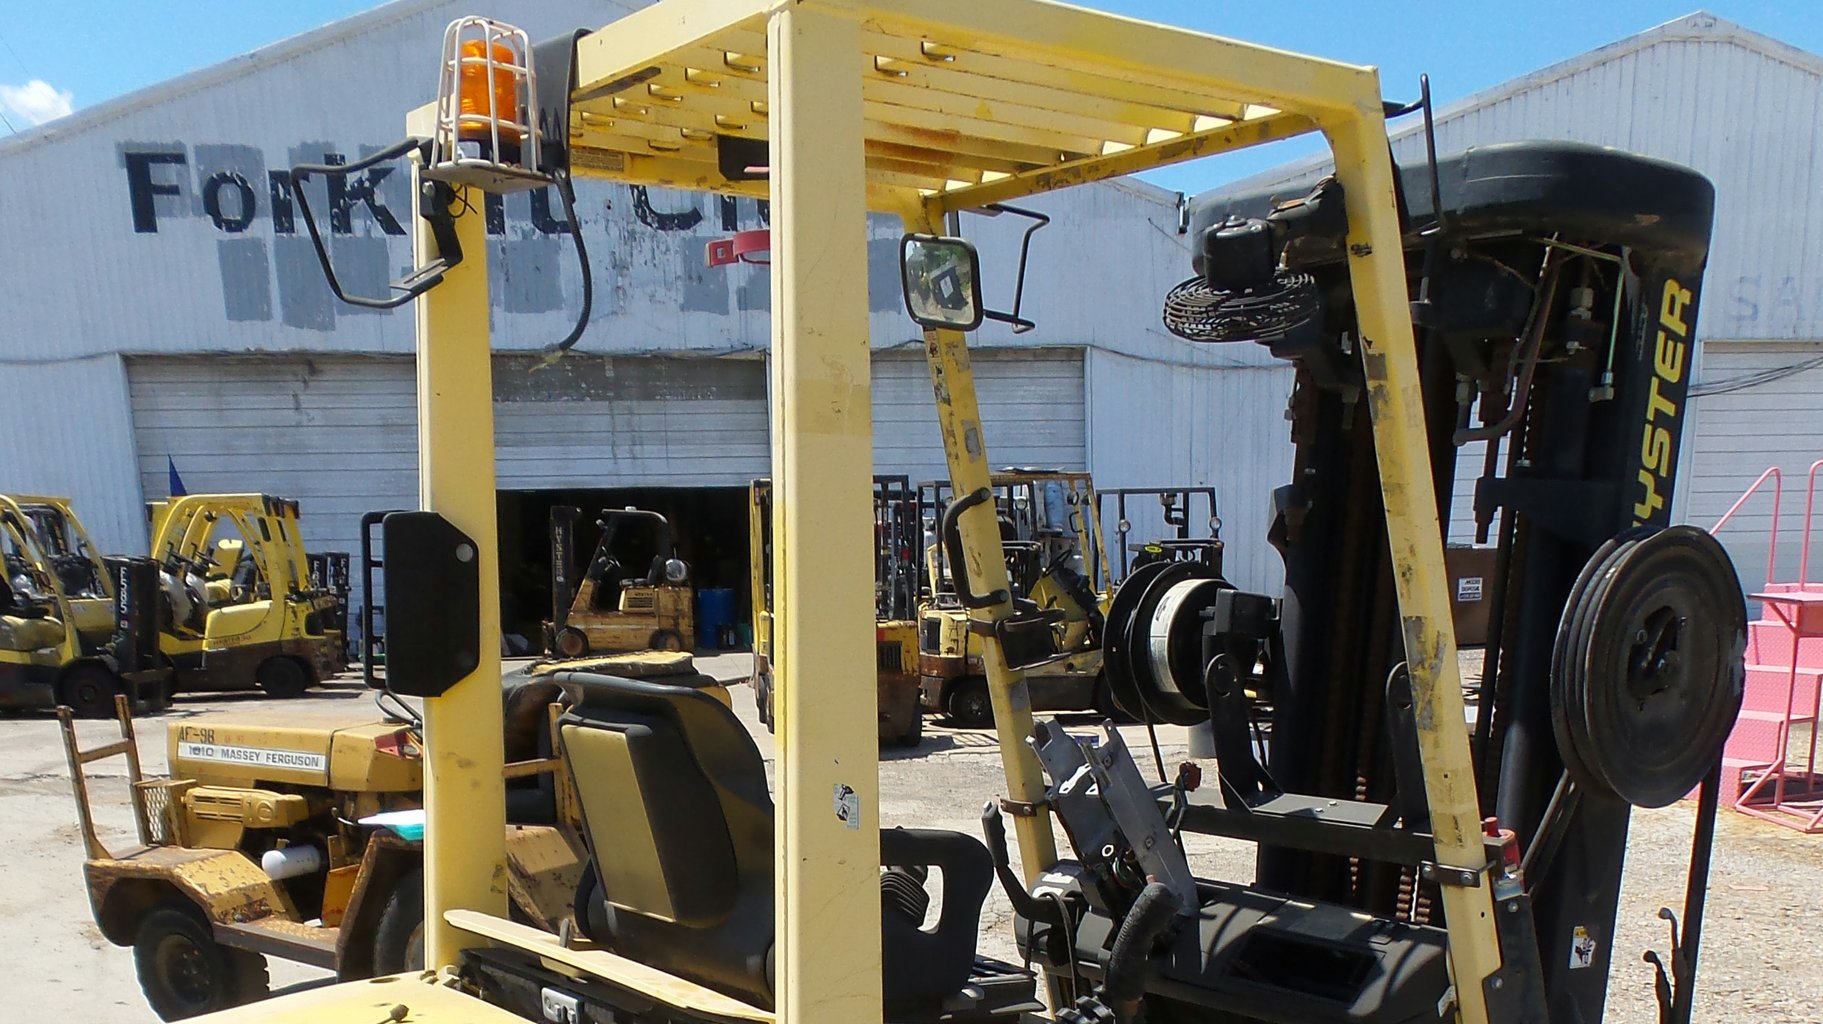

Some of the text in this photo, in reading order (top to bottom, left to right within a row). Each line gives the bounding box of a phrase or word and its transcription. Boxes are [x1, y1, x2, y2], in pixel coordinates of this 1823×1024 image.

[1632, 278, 1692, 528] YSTER
[221, 748, 261, 762] MASSEY
[266, 753, 319, 768] FERGUSON
